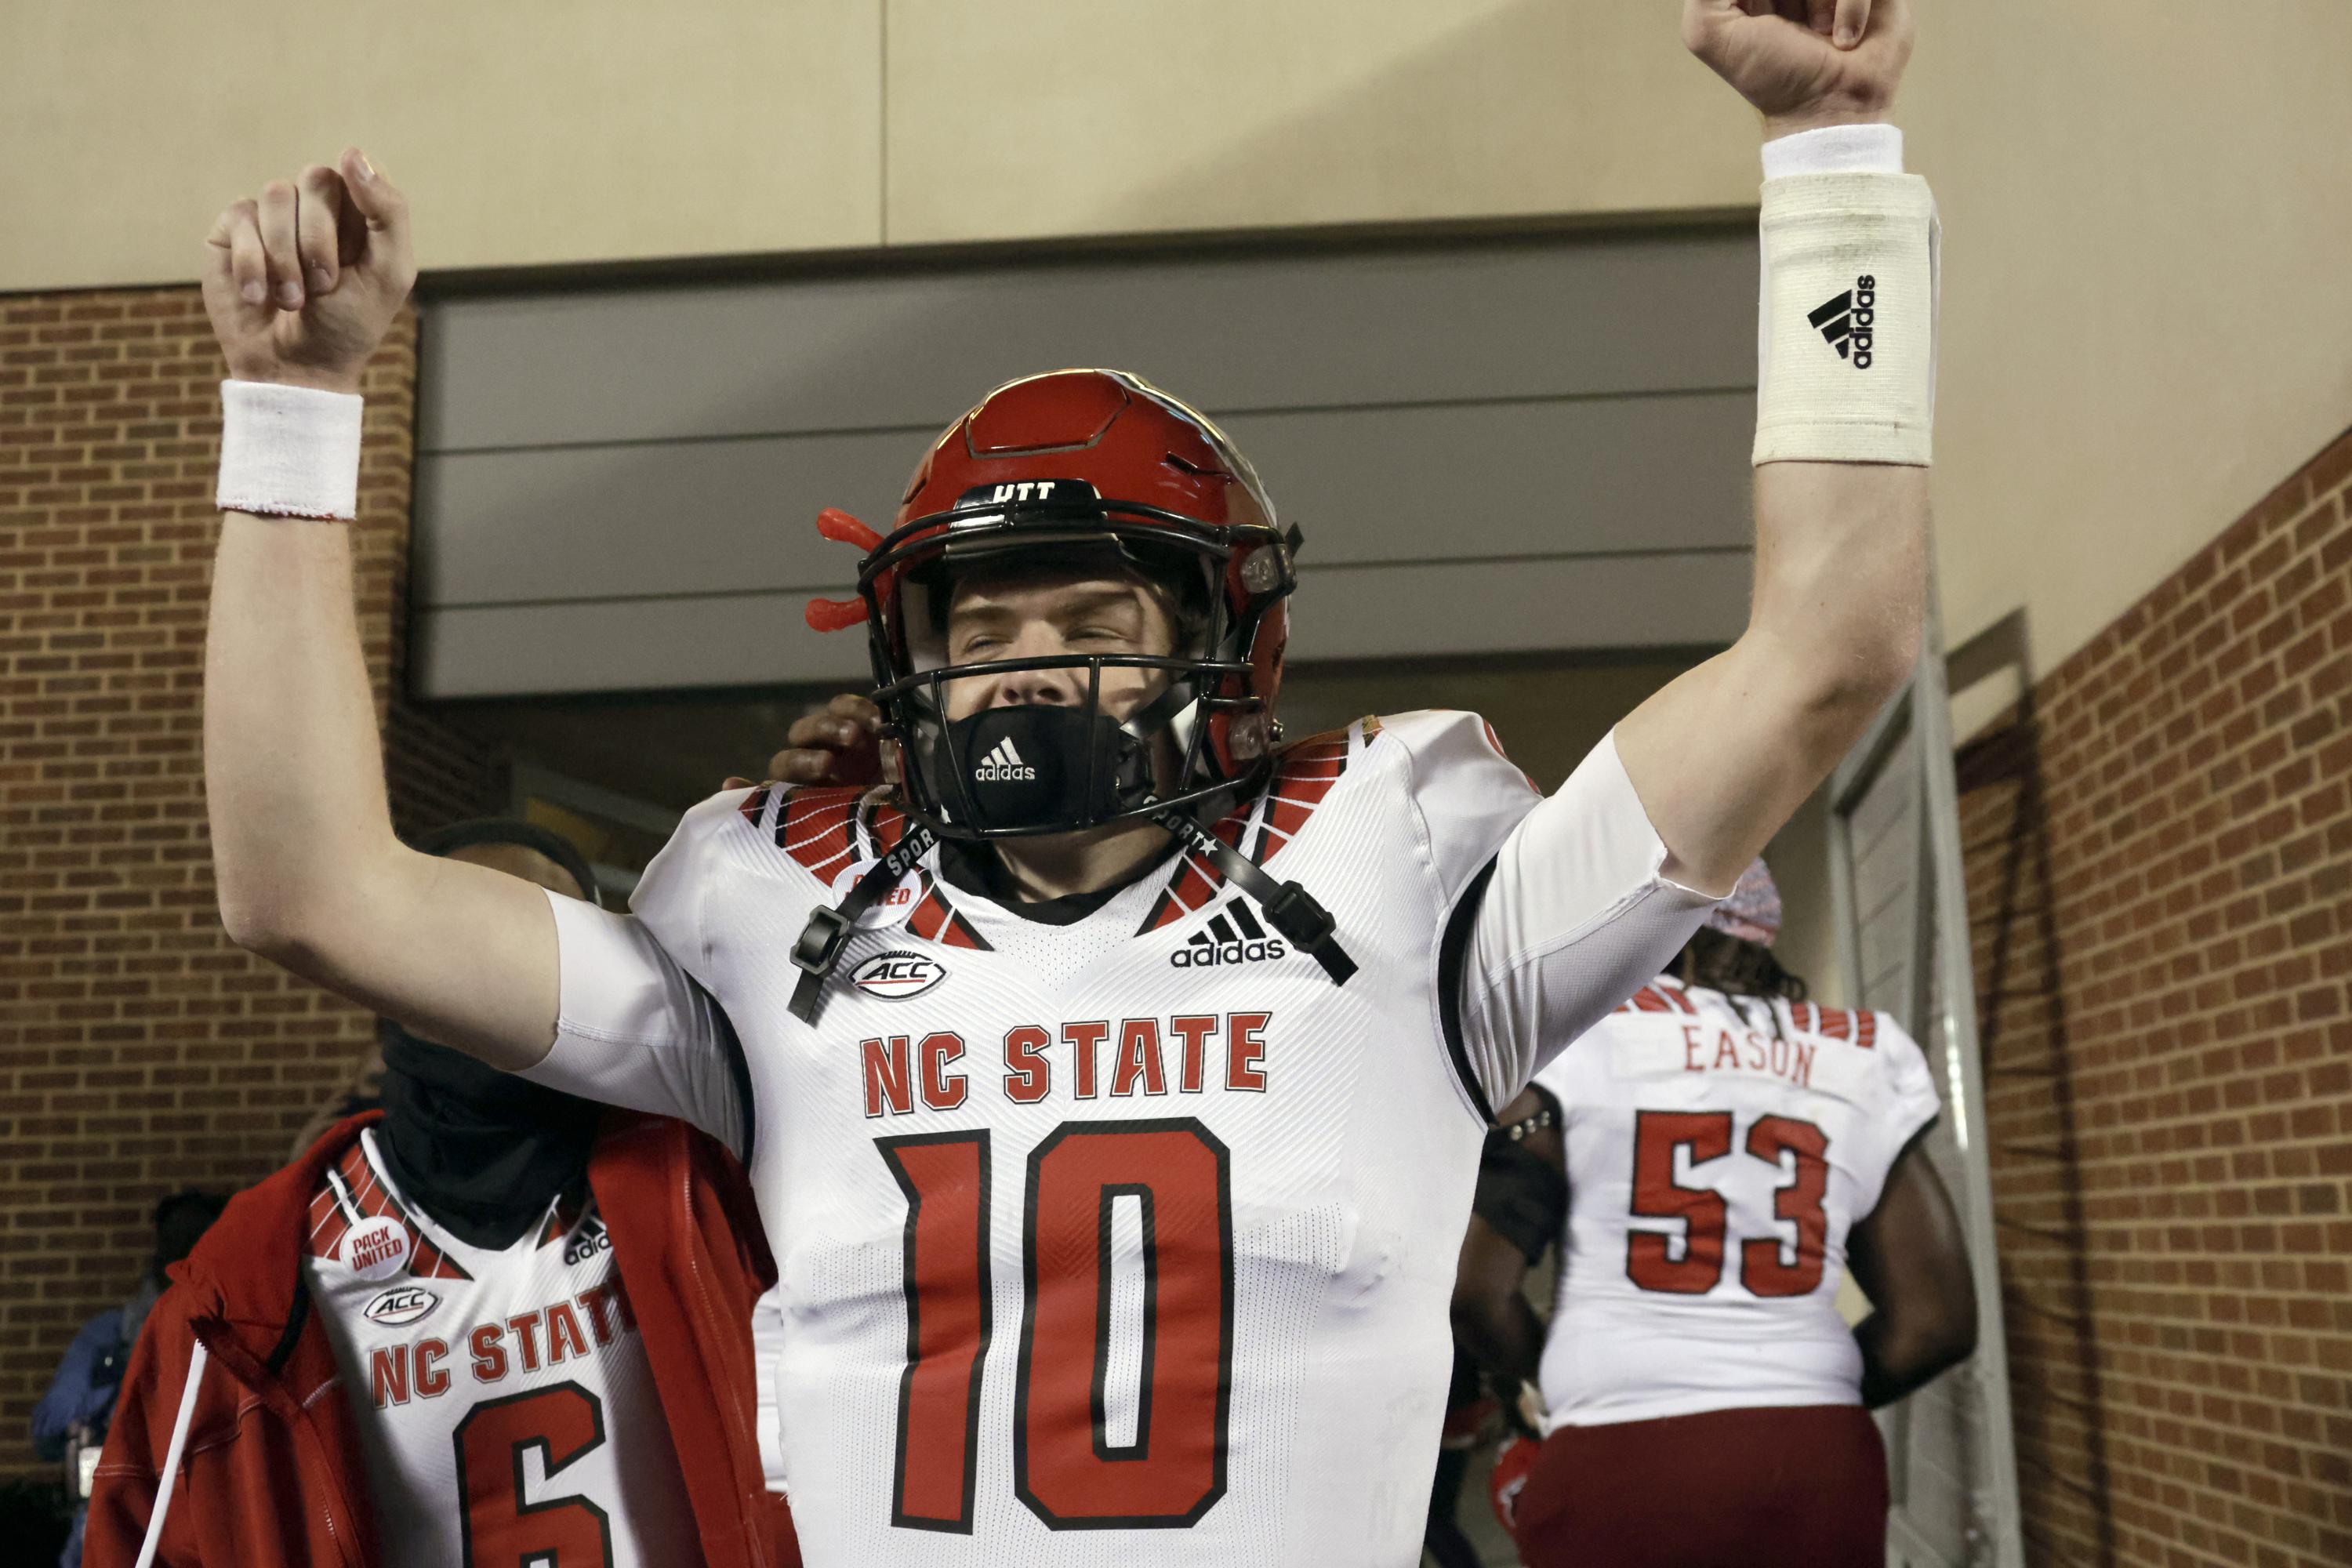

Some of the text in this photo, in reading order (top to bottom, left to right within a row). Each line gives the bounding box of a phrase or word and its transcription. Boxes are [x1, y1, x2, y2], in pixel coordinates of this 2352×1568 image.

[1848, 274, 1876, 370] adidas
[975, 764, 1036, 782] adidas
[886, 828, 935, 877] SPOR
[862, 961, 934, 980] ACC
[1170, 938, 1286, 968] adidas
[859, 1011, 1272, 1118] NC STATE
[1681, 1025, 1817, 1089] EASON
[1626, 1109, 1831, 1298] 53
[352, 1238, 403, 1272] UNITED
[353, 1225, 390, 1254] PACK
[375, 1293, 426, 1314] ACC
[872, 1116, 1235, 1536] 10
[370, 1337, 452, 1410] NC
[452, 1380, 615, 1568] 6
